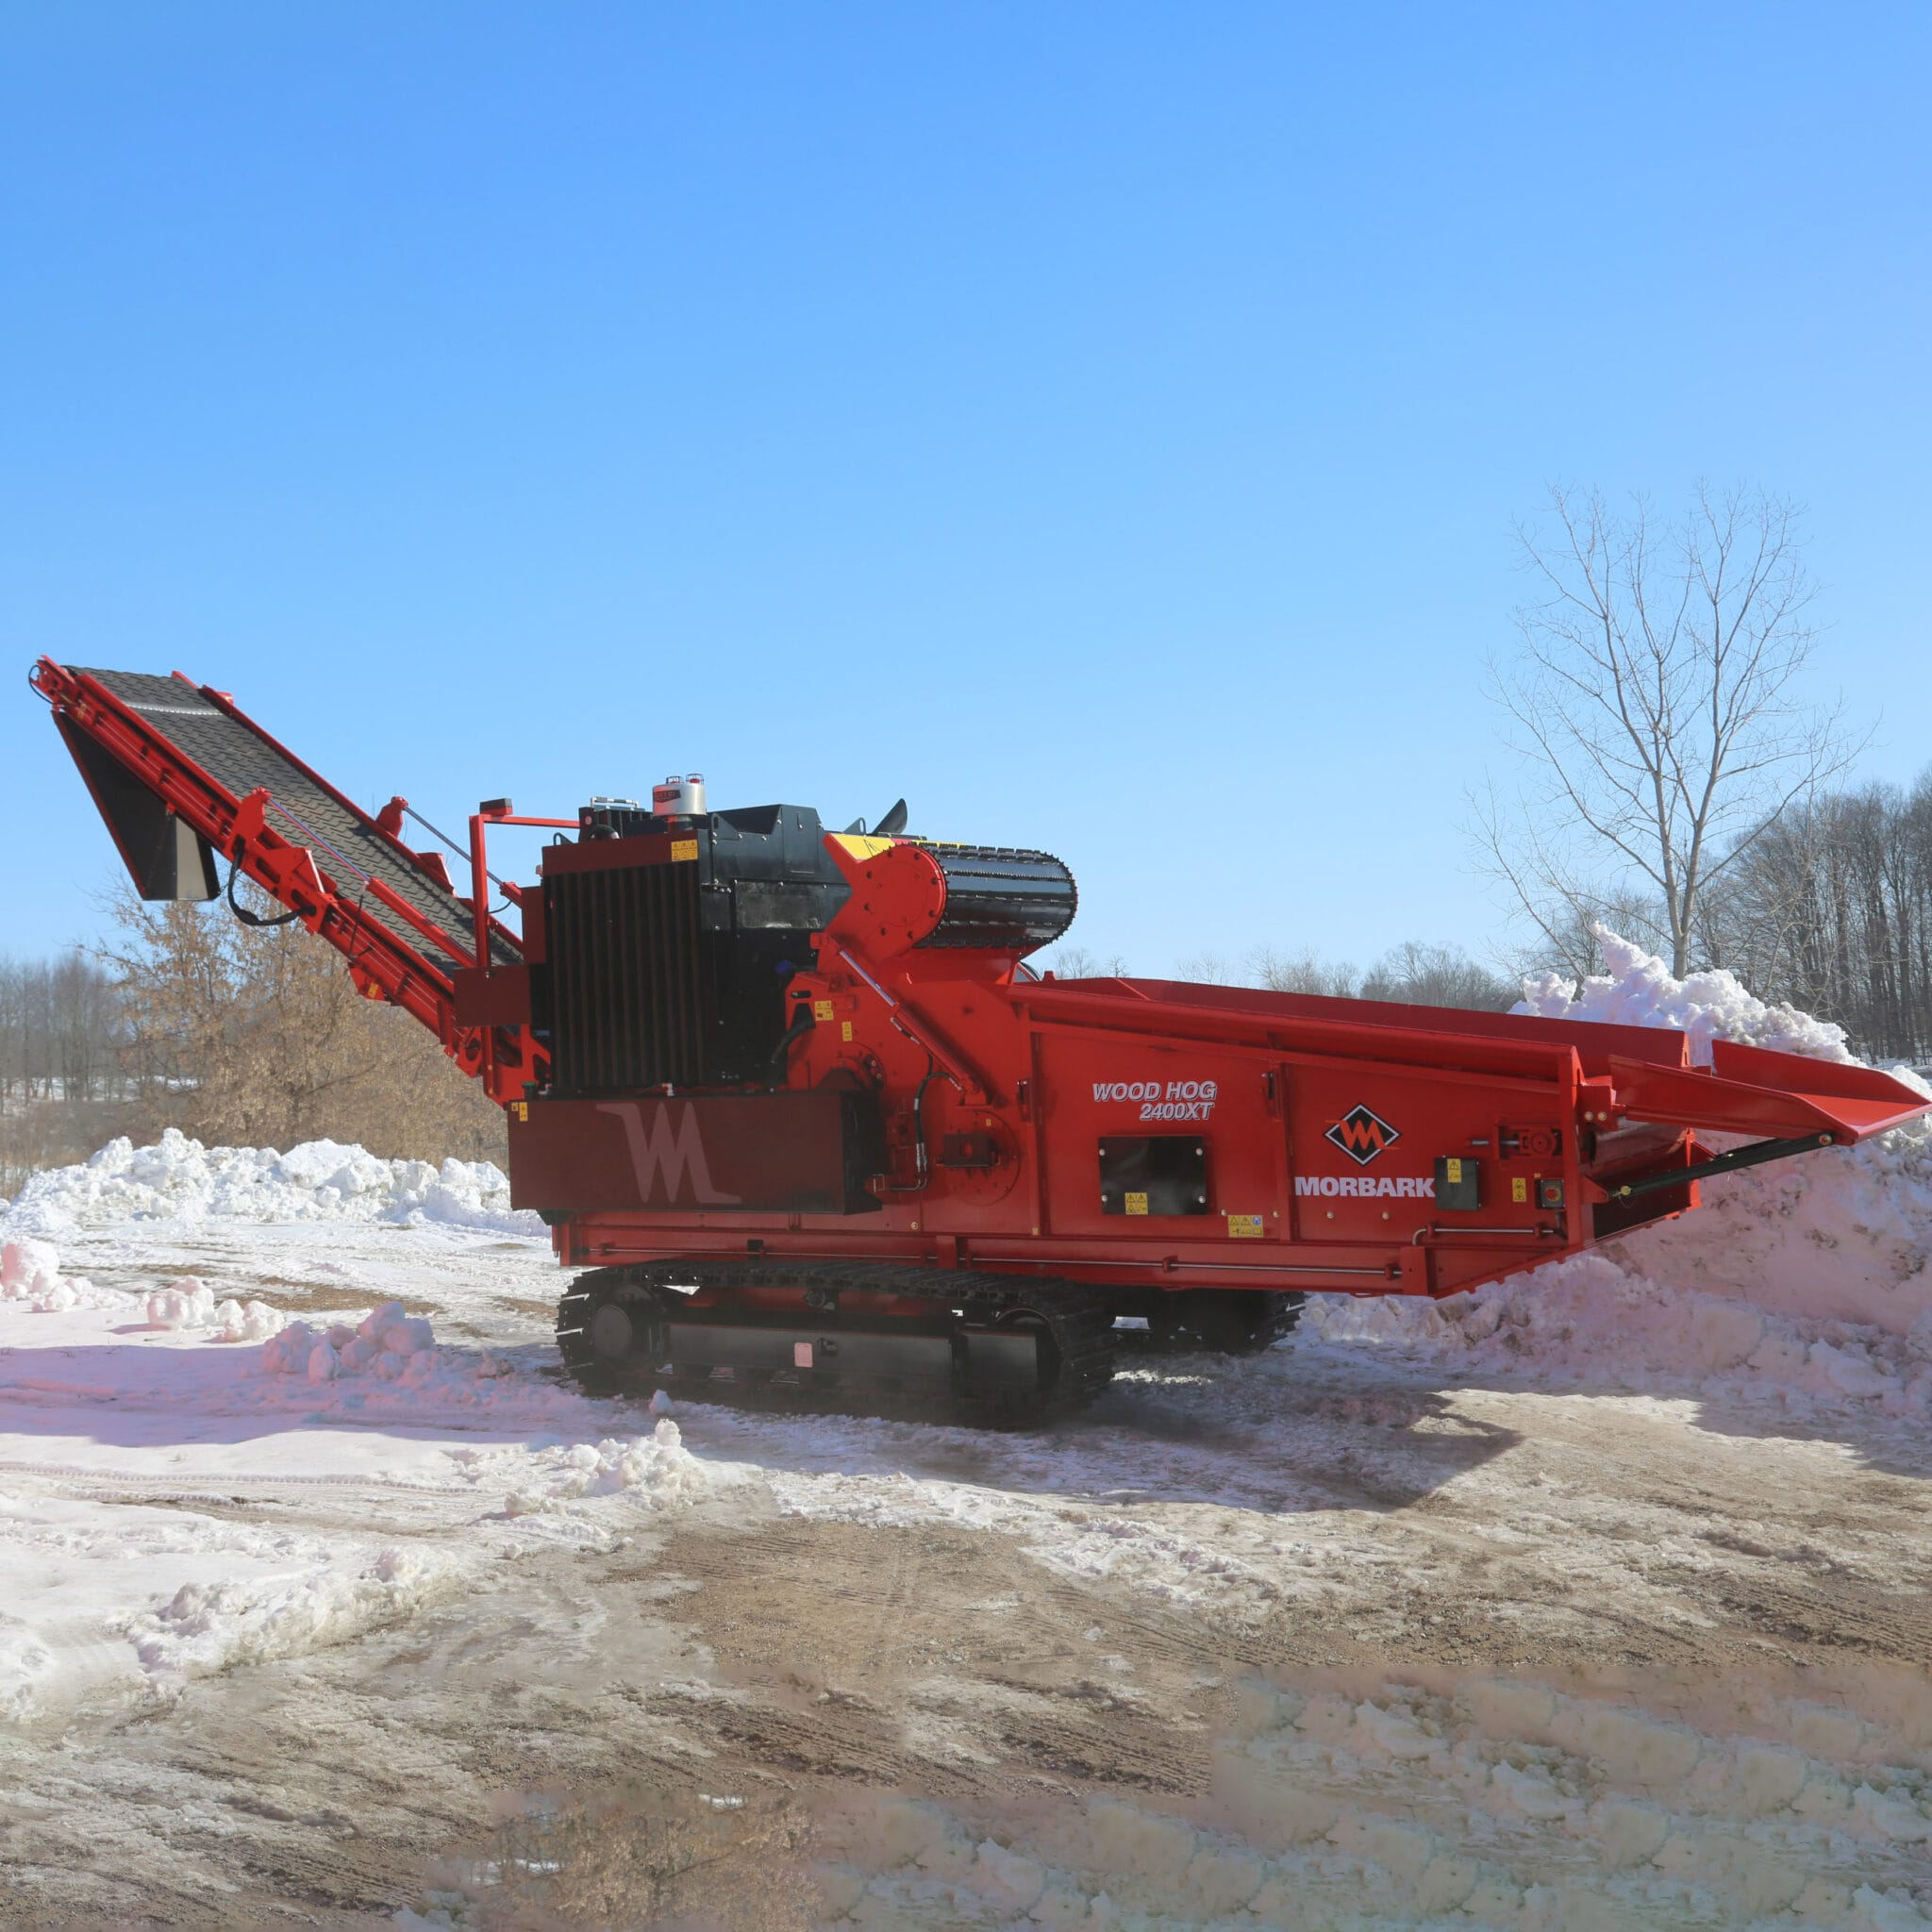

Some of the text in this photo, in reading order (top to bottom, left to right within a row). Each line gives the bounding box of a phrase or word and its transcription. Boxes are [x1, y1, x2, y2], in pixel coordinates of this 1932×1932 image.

[1092, 1080, 1217, 1102] WOOD HOG
[1140, 1102, 1215, 1121] 2400XT
[1294, 1176, 1436, 1197] MORBARK
